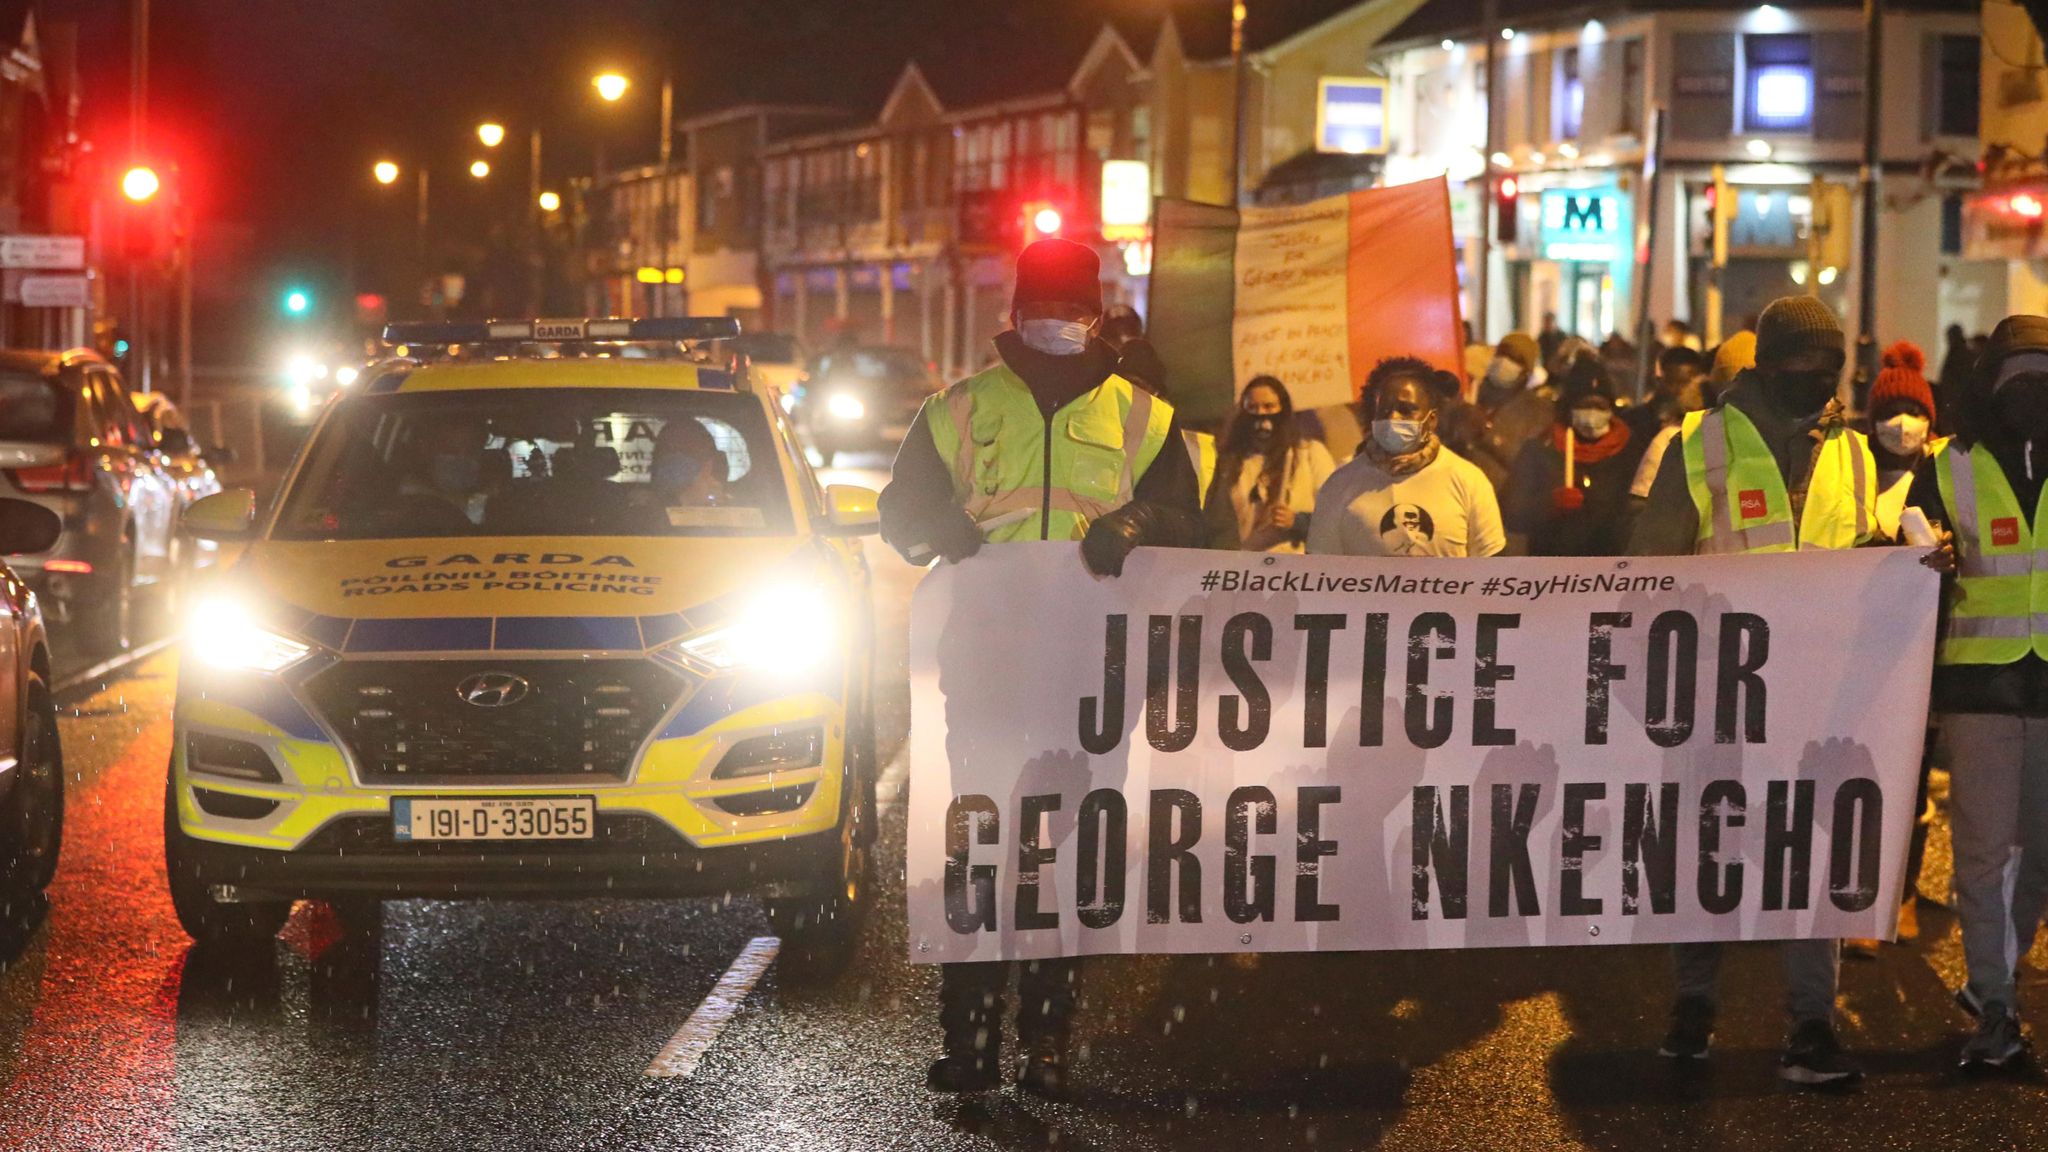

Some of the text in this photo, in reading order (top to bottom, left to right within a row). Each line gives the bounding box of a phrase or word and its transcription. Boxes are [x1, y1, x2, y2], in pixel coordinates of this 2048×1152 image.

[537, 327, 580, 337] GARDA
[1741, 499, 1761, 509] RSA
[385, 553, 635, 569] GARDA
[343, 581, 656, 597] ROADS POLICING
[1201, 570, 1677, 601] #BlackLivesMatter #SayHisName
[1078, 610, 1771, 756] JUSTICE FOR
[430, 808, 586, 837] 191-D-33055
[943, 777, 1884, 936] GEORGE NKENCHO
